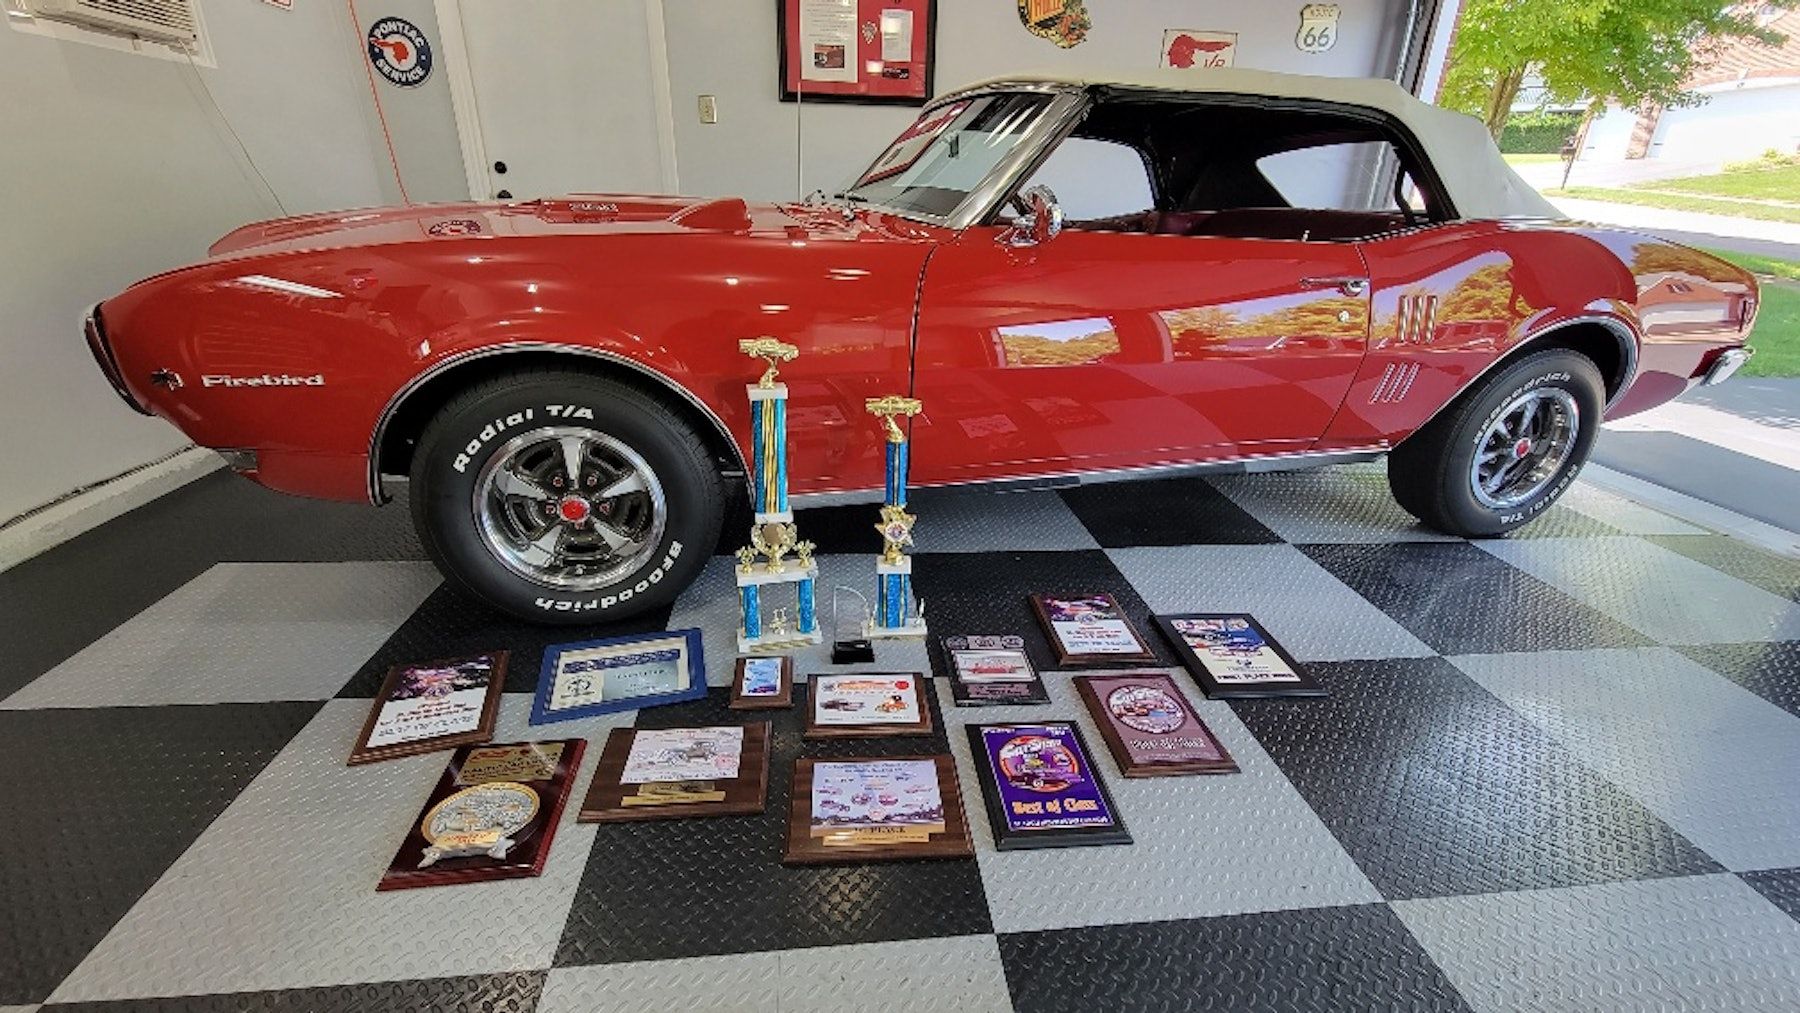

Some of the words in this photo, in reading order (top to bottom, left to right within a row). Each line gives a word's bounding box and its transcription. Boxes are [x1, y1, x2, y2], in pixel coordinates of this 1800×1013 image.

[374, 21, 425, 47] PONTIAC
[1303, 26, 1329, 47] 66
[375, 58, 425, 82] SERVICE
[201, 373, 326, 388] Firebird
[452, 407, 534, 473] Radial
[545, 404, 594, 420] T/A
[1012, 801, 1043, 814] Best
[1046, 799, 1062, 814] of
